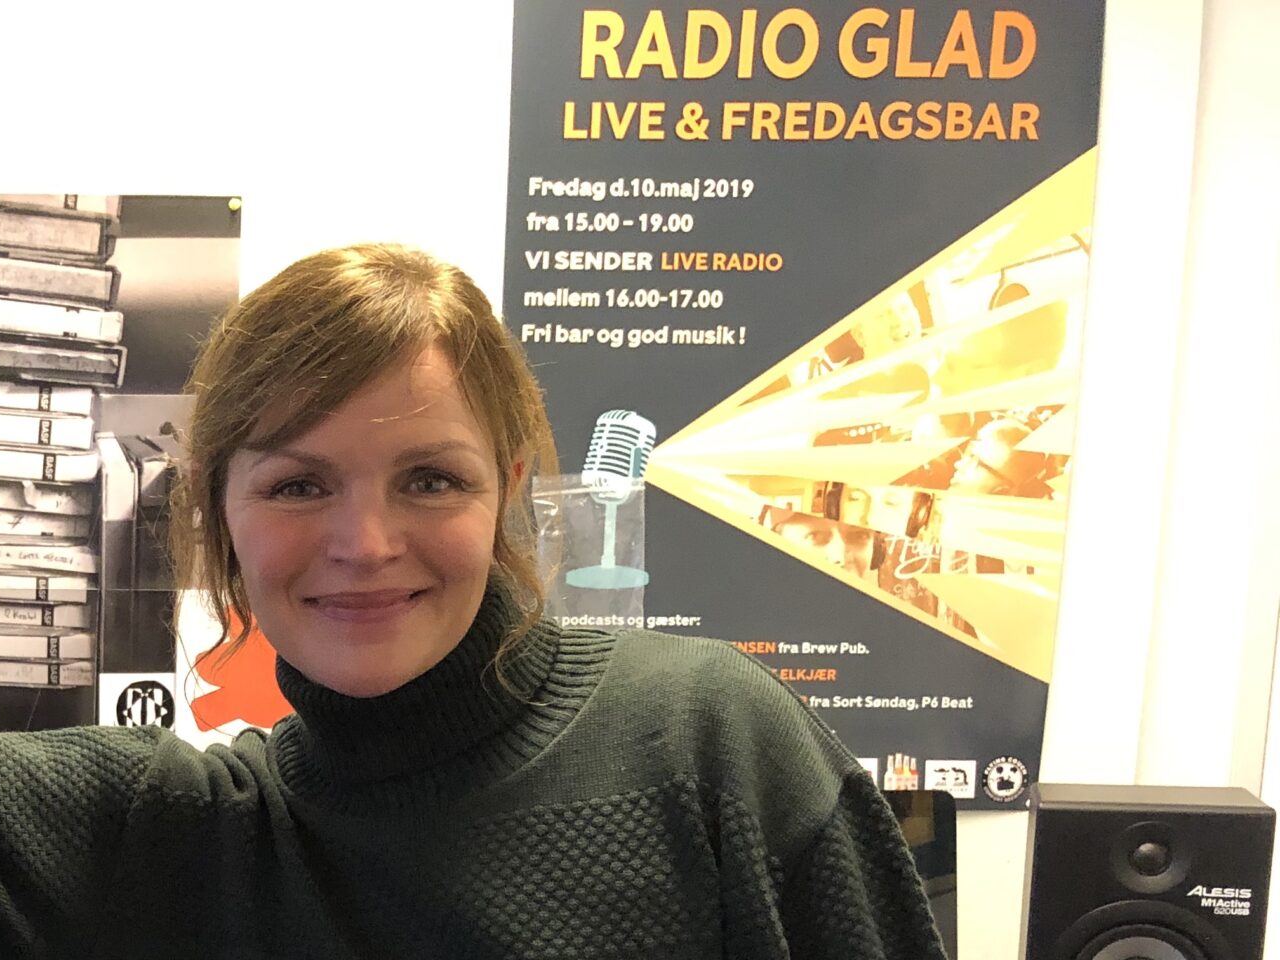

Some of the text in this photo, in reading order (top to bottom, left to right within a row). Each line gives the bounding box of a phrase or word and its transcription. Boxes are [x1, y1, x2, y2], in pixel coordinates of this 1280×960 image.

[580, 7, 1037, 79] RADIO GLAD
[563, 101, 1040, 141] LIVE & FREDAGSBAR
[529, 176, 606, 201] Fredag
[703, 179, 754, 198] 2019
[526, 212, 559, 231] fra
[565, 213, 619, 232] 15.00
[639, 213, 693, 232] 19.00
[525, 251, 782, 271] VI SENDER LIVE RADIO
[523, 288, 723, 308] mellem 16.00-17.00
[521, 324, 552, 343] Fri
[555, 325, 594, 343] bar
[597, 329, 624, 348] og
[627, 326, 669, 348] god
[672, 326, 735, 344] musik
[40, 421, 50, 444] BASF
[45, 456, 55, 480] BASF
[562, 615, 624, 627] podcasts
[627, 617, 644, 628] og
[646, 616, 701, 629] gæster:
[778, 642, 799, 654] fra
[802, 642, 838, 654] Brew
[840, 642, 870, 655] Pub.
[780, 668, 836, 681] ELKJÆR
[809, 696, 829, 708] fra
[833, 696, 863, 708] Sort
[865, 696, 919, 711] Søndag,
[922, 697, 938, 708] P6
[941, 697, 973, 709] Beat
[1186, 884, 1252, 898] ALESIS
